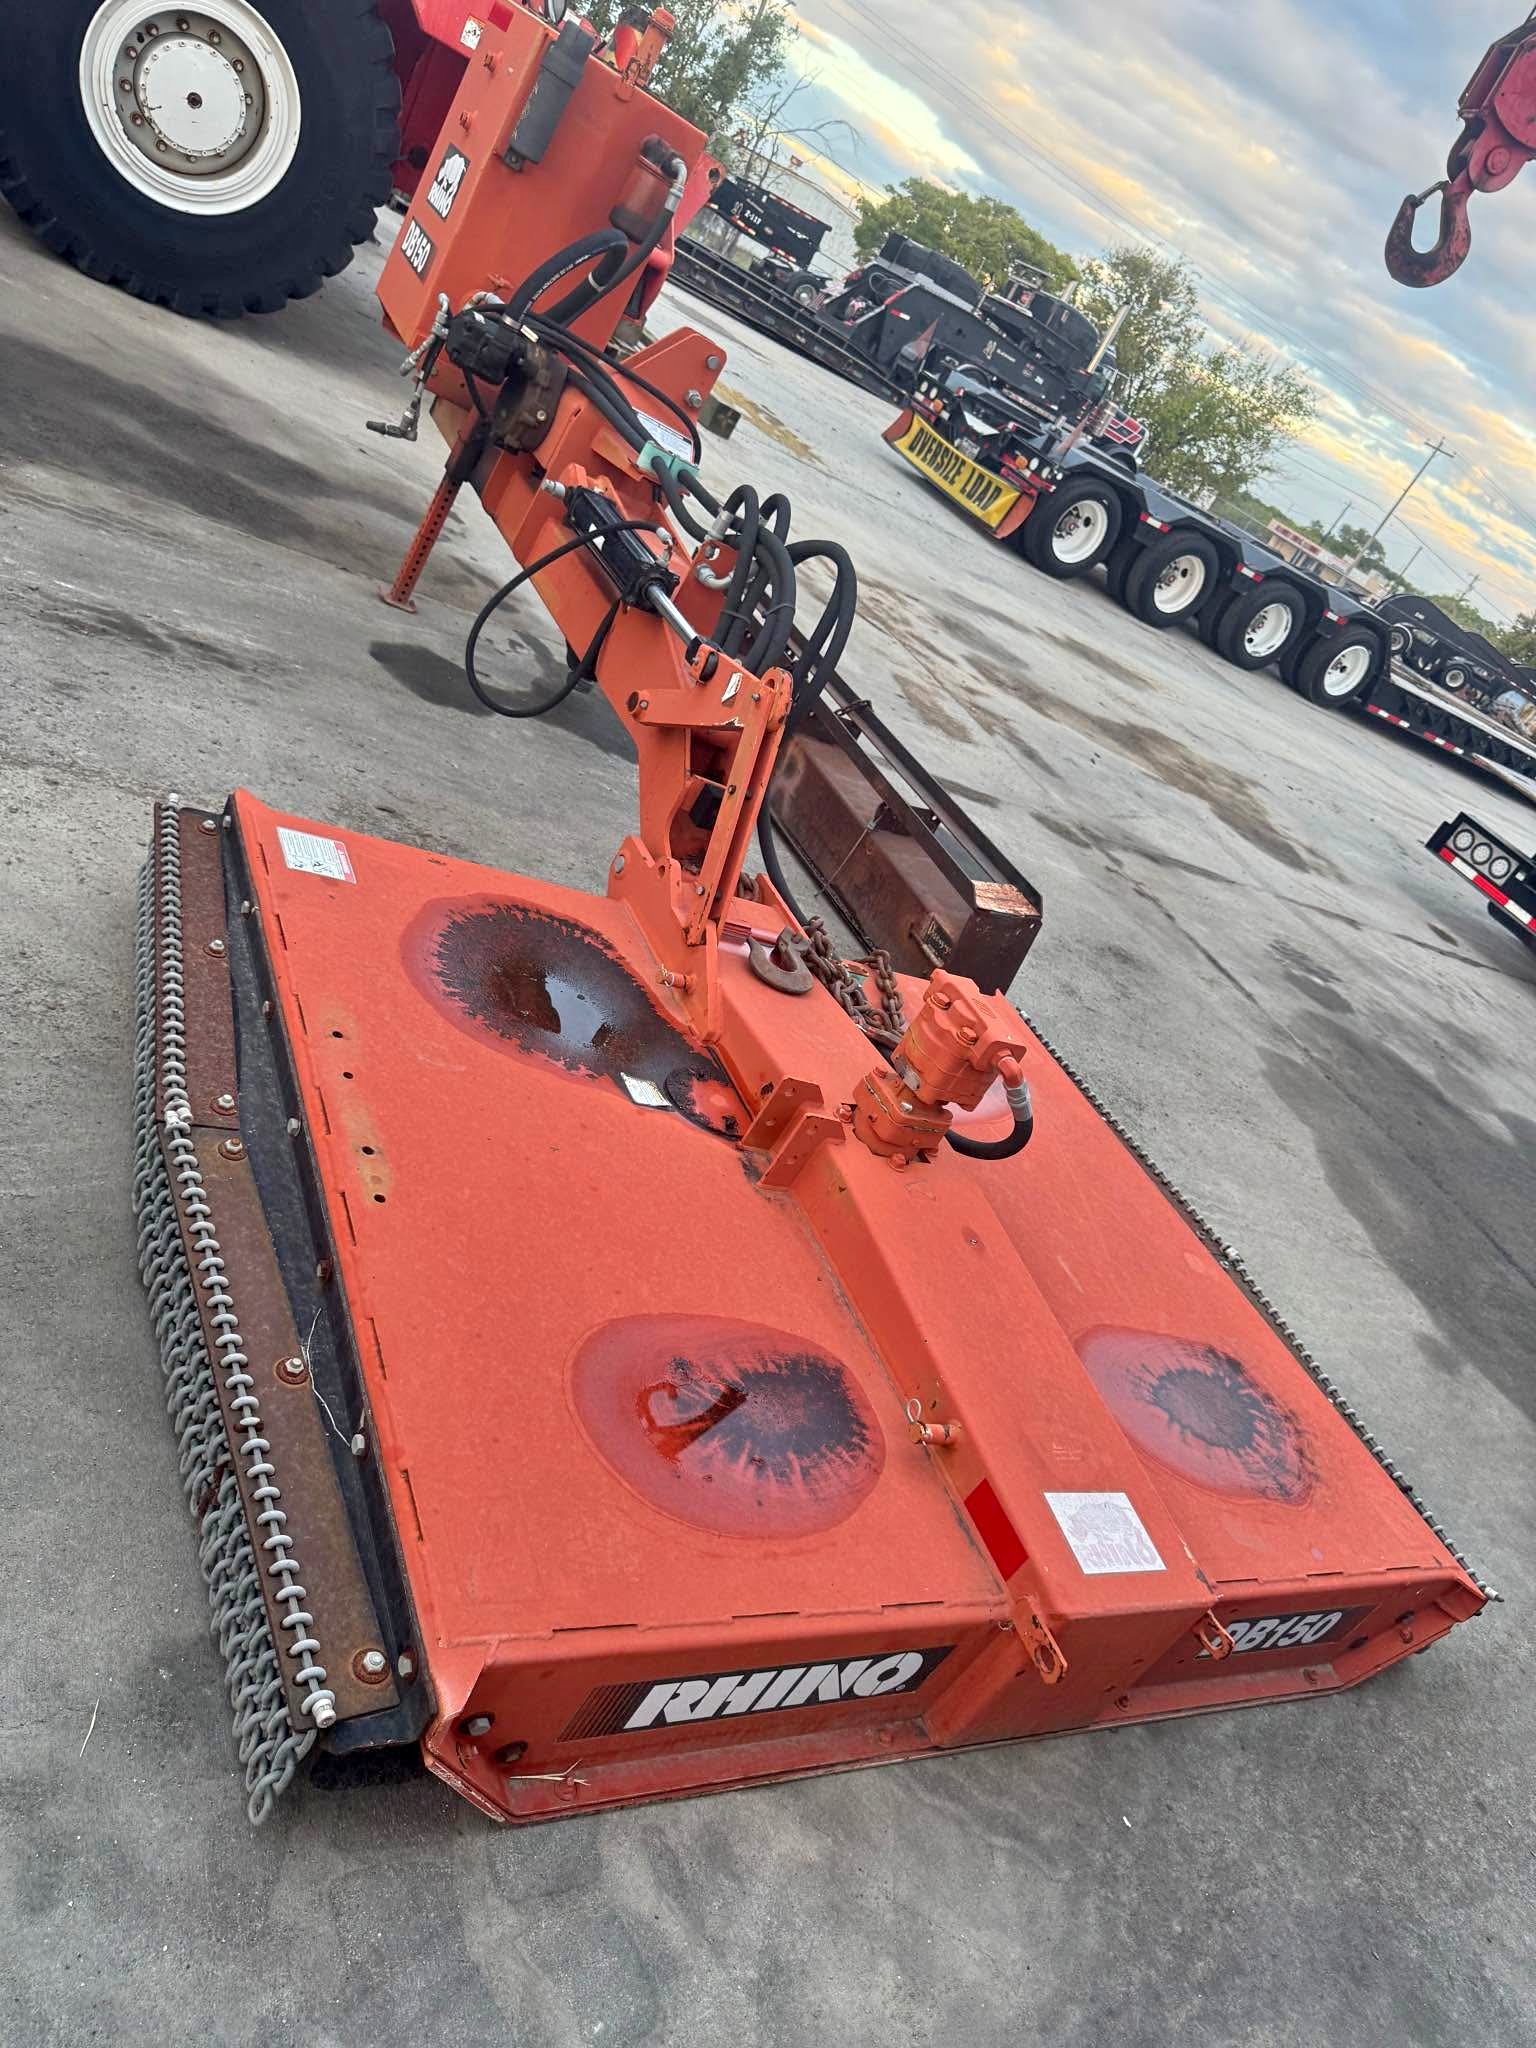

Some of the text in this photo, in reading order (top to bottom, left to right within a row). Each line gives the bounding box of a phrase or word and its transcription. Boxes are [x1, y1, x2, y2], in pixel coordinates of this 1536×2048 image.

[401, 219, 431, 273] DB150
[908, 427, 967, 486] OVERSIZE
[959, 467, 1002, 512] LOAD
[623, 1651, 924, 1730] RHINO
